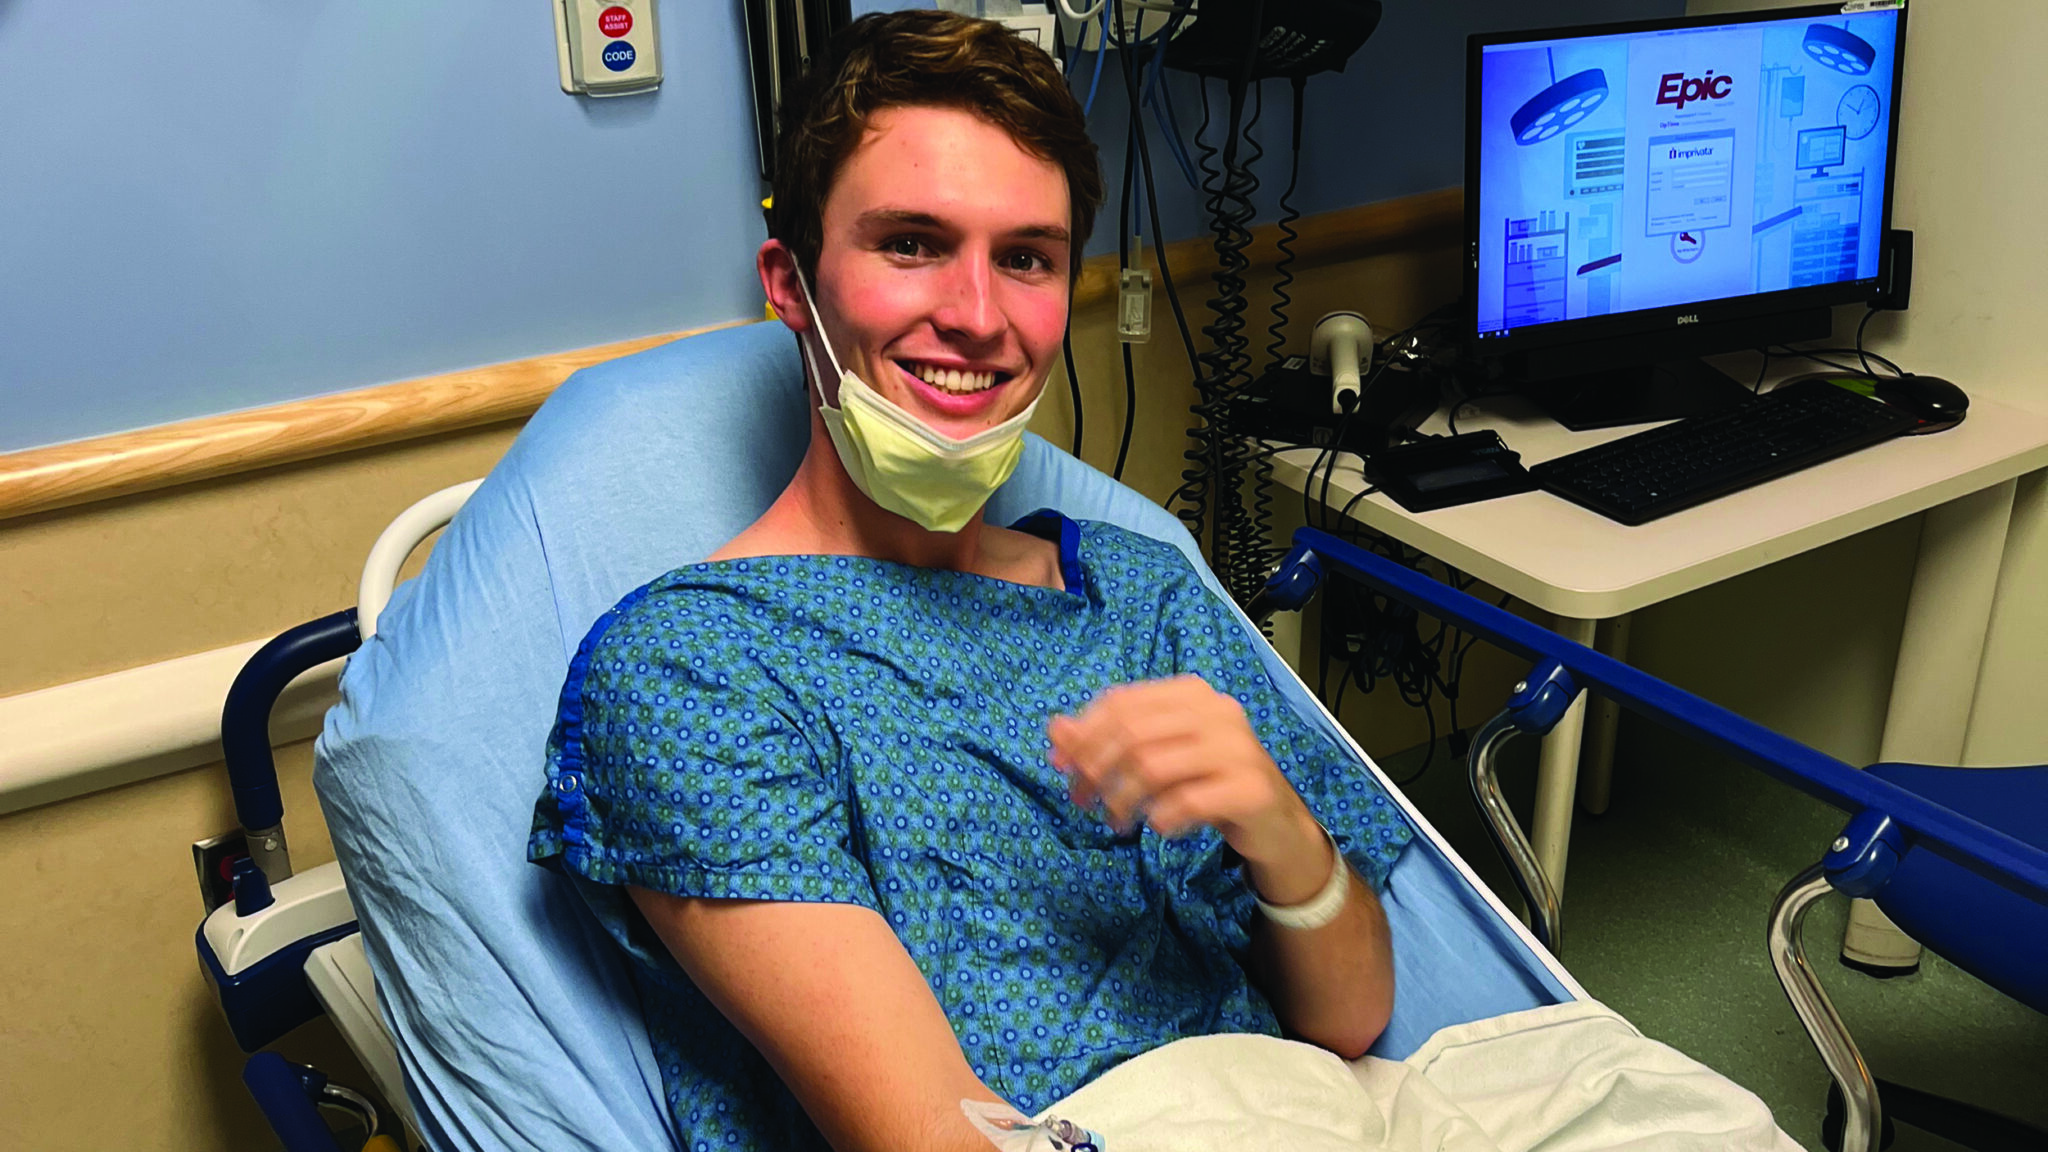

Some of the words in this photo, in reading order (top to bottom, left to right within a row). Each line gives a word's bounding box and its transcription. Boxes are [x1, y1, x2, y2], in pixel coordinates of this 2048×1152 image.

[605, 14, 626, 22] STAFF
[604, 22, 628, 30] ASSIST
[605, 50, 633, 62] CODE
[1656, 69, 1733, 110] Epic
[1677, 314, 1699, 325] DELL
